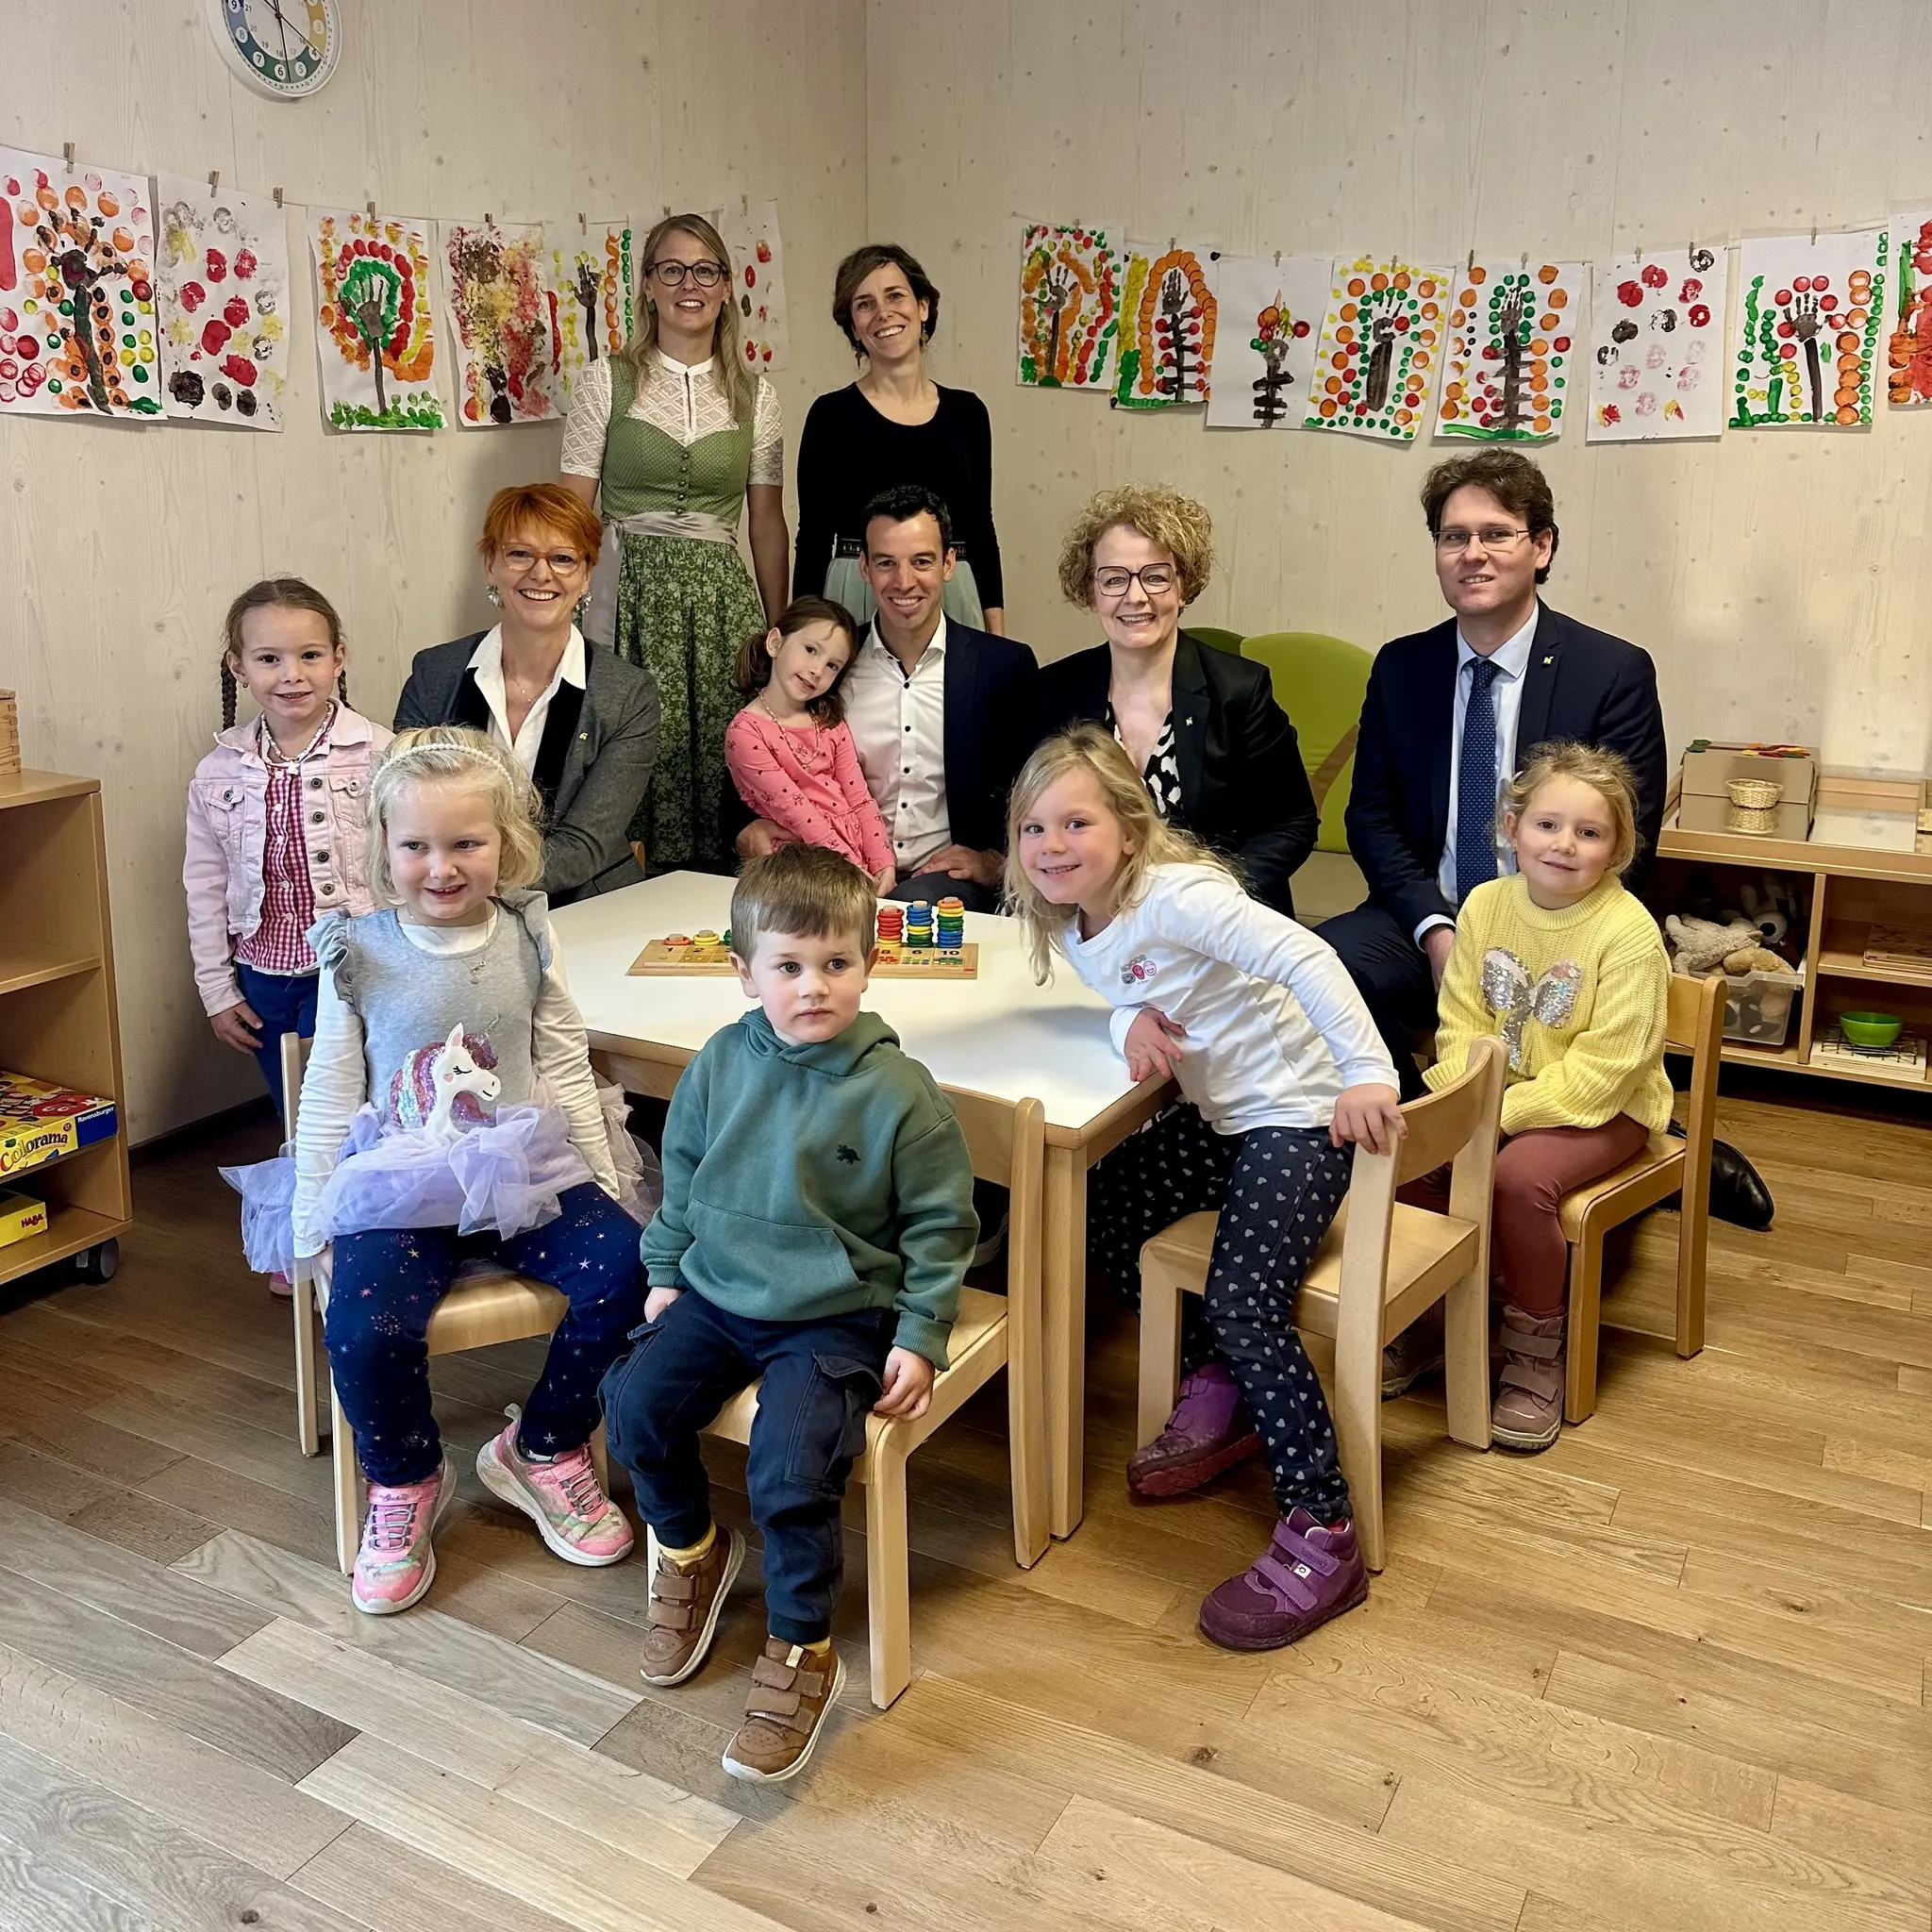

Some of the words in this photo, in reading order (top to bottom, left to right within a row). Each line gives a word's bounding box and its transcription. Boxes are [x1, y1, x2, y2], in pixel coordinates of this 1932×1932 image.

[231, 0, 238, 9] 9
[244, 4, 252, 12] 21
[316, 22, 322, 32] 3
[239, 29, 245, 40] 8
[261, 41, 269, 49] 19
[275, 49, 284, 58] 18
[256, 54, 262, 64] 7
[277, 67, 284, 76] 6
[298, 64, 304, 74] 5
[77, 1107, 114, 1123] Ravensburger
[1, 1133, 68, 1172] Colorama
[21, 1213, 43, 1227] HABA
